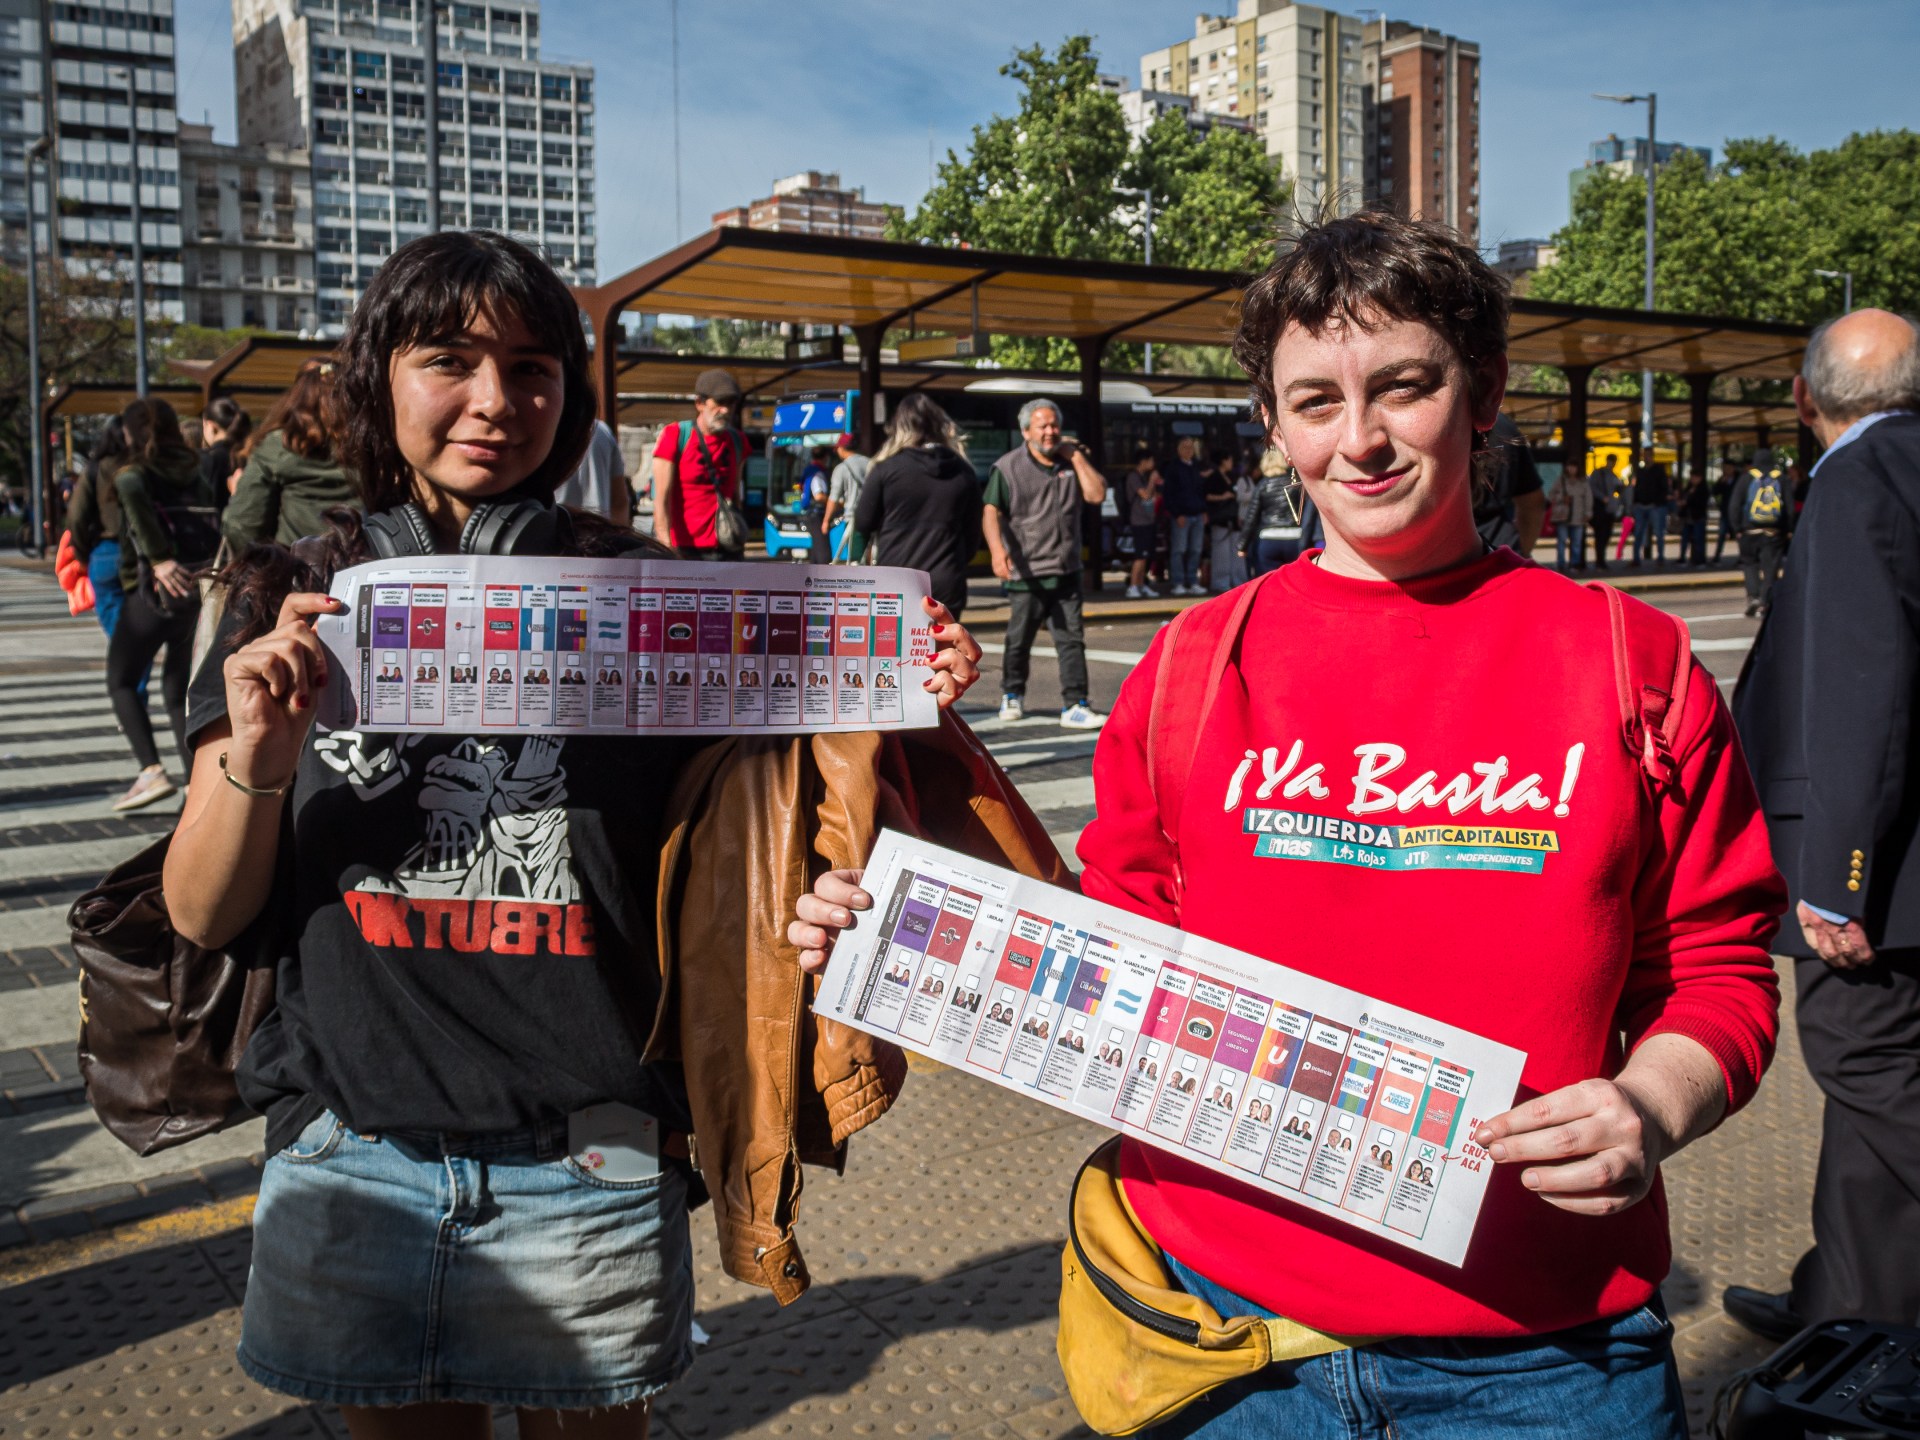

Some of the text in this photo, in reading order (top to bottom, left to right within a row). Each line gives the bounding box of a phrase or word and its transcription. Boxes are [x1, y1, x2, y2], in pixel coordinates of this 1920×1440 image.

[800, 403, 815, 429] 7
[911, 628, 930, 636] HACE
[912, 638, 928, 646] UNA
[1347, 742, 1585, 817] Basta!
[1248, 810, 1552, 848] IZQUIERDA ANTICAPITALISTA
[1405, 851, 1429, 865] JTP
[1456, 852, 1533, 866] INDEPENDIENTES
[946, 902, 962, 911] BUENOS
[947, 896, 976, 910] PARTIDO NUEVO
[1021, 920, 1036, 928] FRENTE
[1102, 923, 1121, 934] MARQUE
[1020, 925, 1040, 936] IZQUIERDA
[1060, 933, 1075, 942] FRENTE
[1054, 944, 1072, 954] FEDERAL
[1099, 954, 1116, 963] LIBERAL
[1123, 959, 1156, 974] ALIANZA FUERZA
[1130, 968, 1145, 977] PATRIA
[857, 985, 872, 1014] DIPUTADOS
[867, 952, 884, 986] NACIONALES
[1194, 994, 1216, 1005] PROYECTO
[1201, 990, 1222, 1001] CULTURAL
[1234, 1002, 1265, 1017] FEDERAL PARA
[1239, 997, 1264, 1010] PROPUESTA
[1243, 1012, 1259, 1021] CAMBIO
[1281, 1012, 1299, 1022] ALIANZA
[1275, 1017, 1300, 1030] PROVINCIAS
[1278, 1024, 1294, 1034] UNIDAS
[1226, 1029, 1254, 1043] SEGURIDAD
[1319, 1030, 1338, 1040] ALIANZA
[1370, 1016, 1445, 1047] Elecciones NACIONALES 2025
[1315, 1035, 1338, 1047] POTENCIA
[1352, 1042, 1371, 1052] ALIANZA
[1224, 1041, 1249, 1054] LIBERTAD
[1267, 1045, 1289, 1065] U
[1356, 1050, 1376, 1061] FEDERAL
[1390, 1056, 1427, 1072] ALIANZA NUEVOS
[1400, 1066, 1413, 1074] AIRES
[1310, 1065, 1332, 1077] potencia
[1436, 1069, 1465, 1083] MOVIMIENTO
[1433, 1081, 1460, 1094] SOCIALISTA
[1436, 1075, 1461, 1088] AVANZADA
[1388, 1091, 1411, 1103] NUEVOS
[1461, 1142, 1490, 1160] CRUZ
